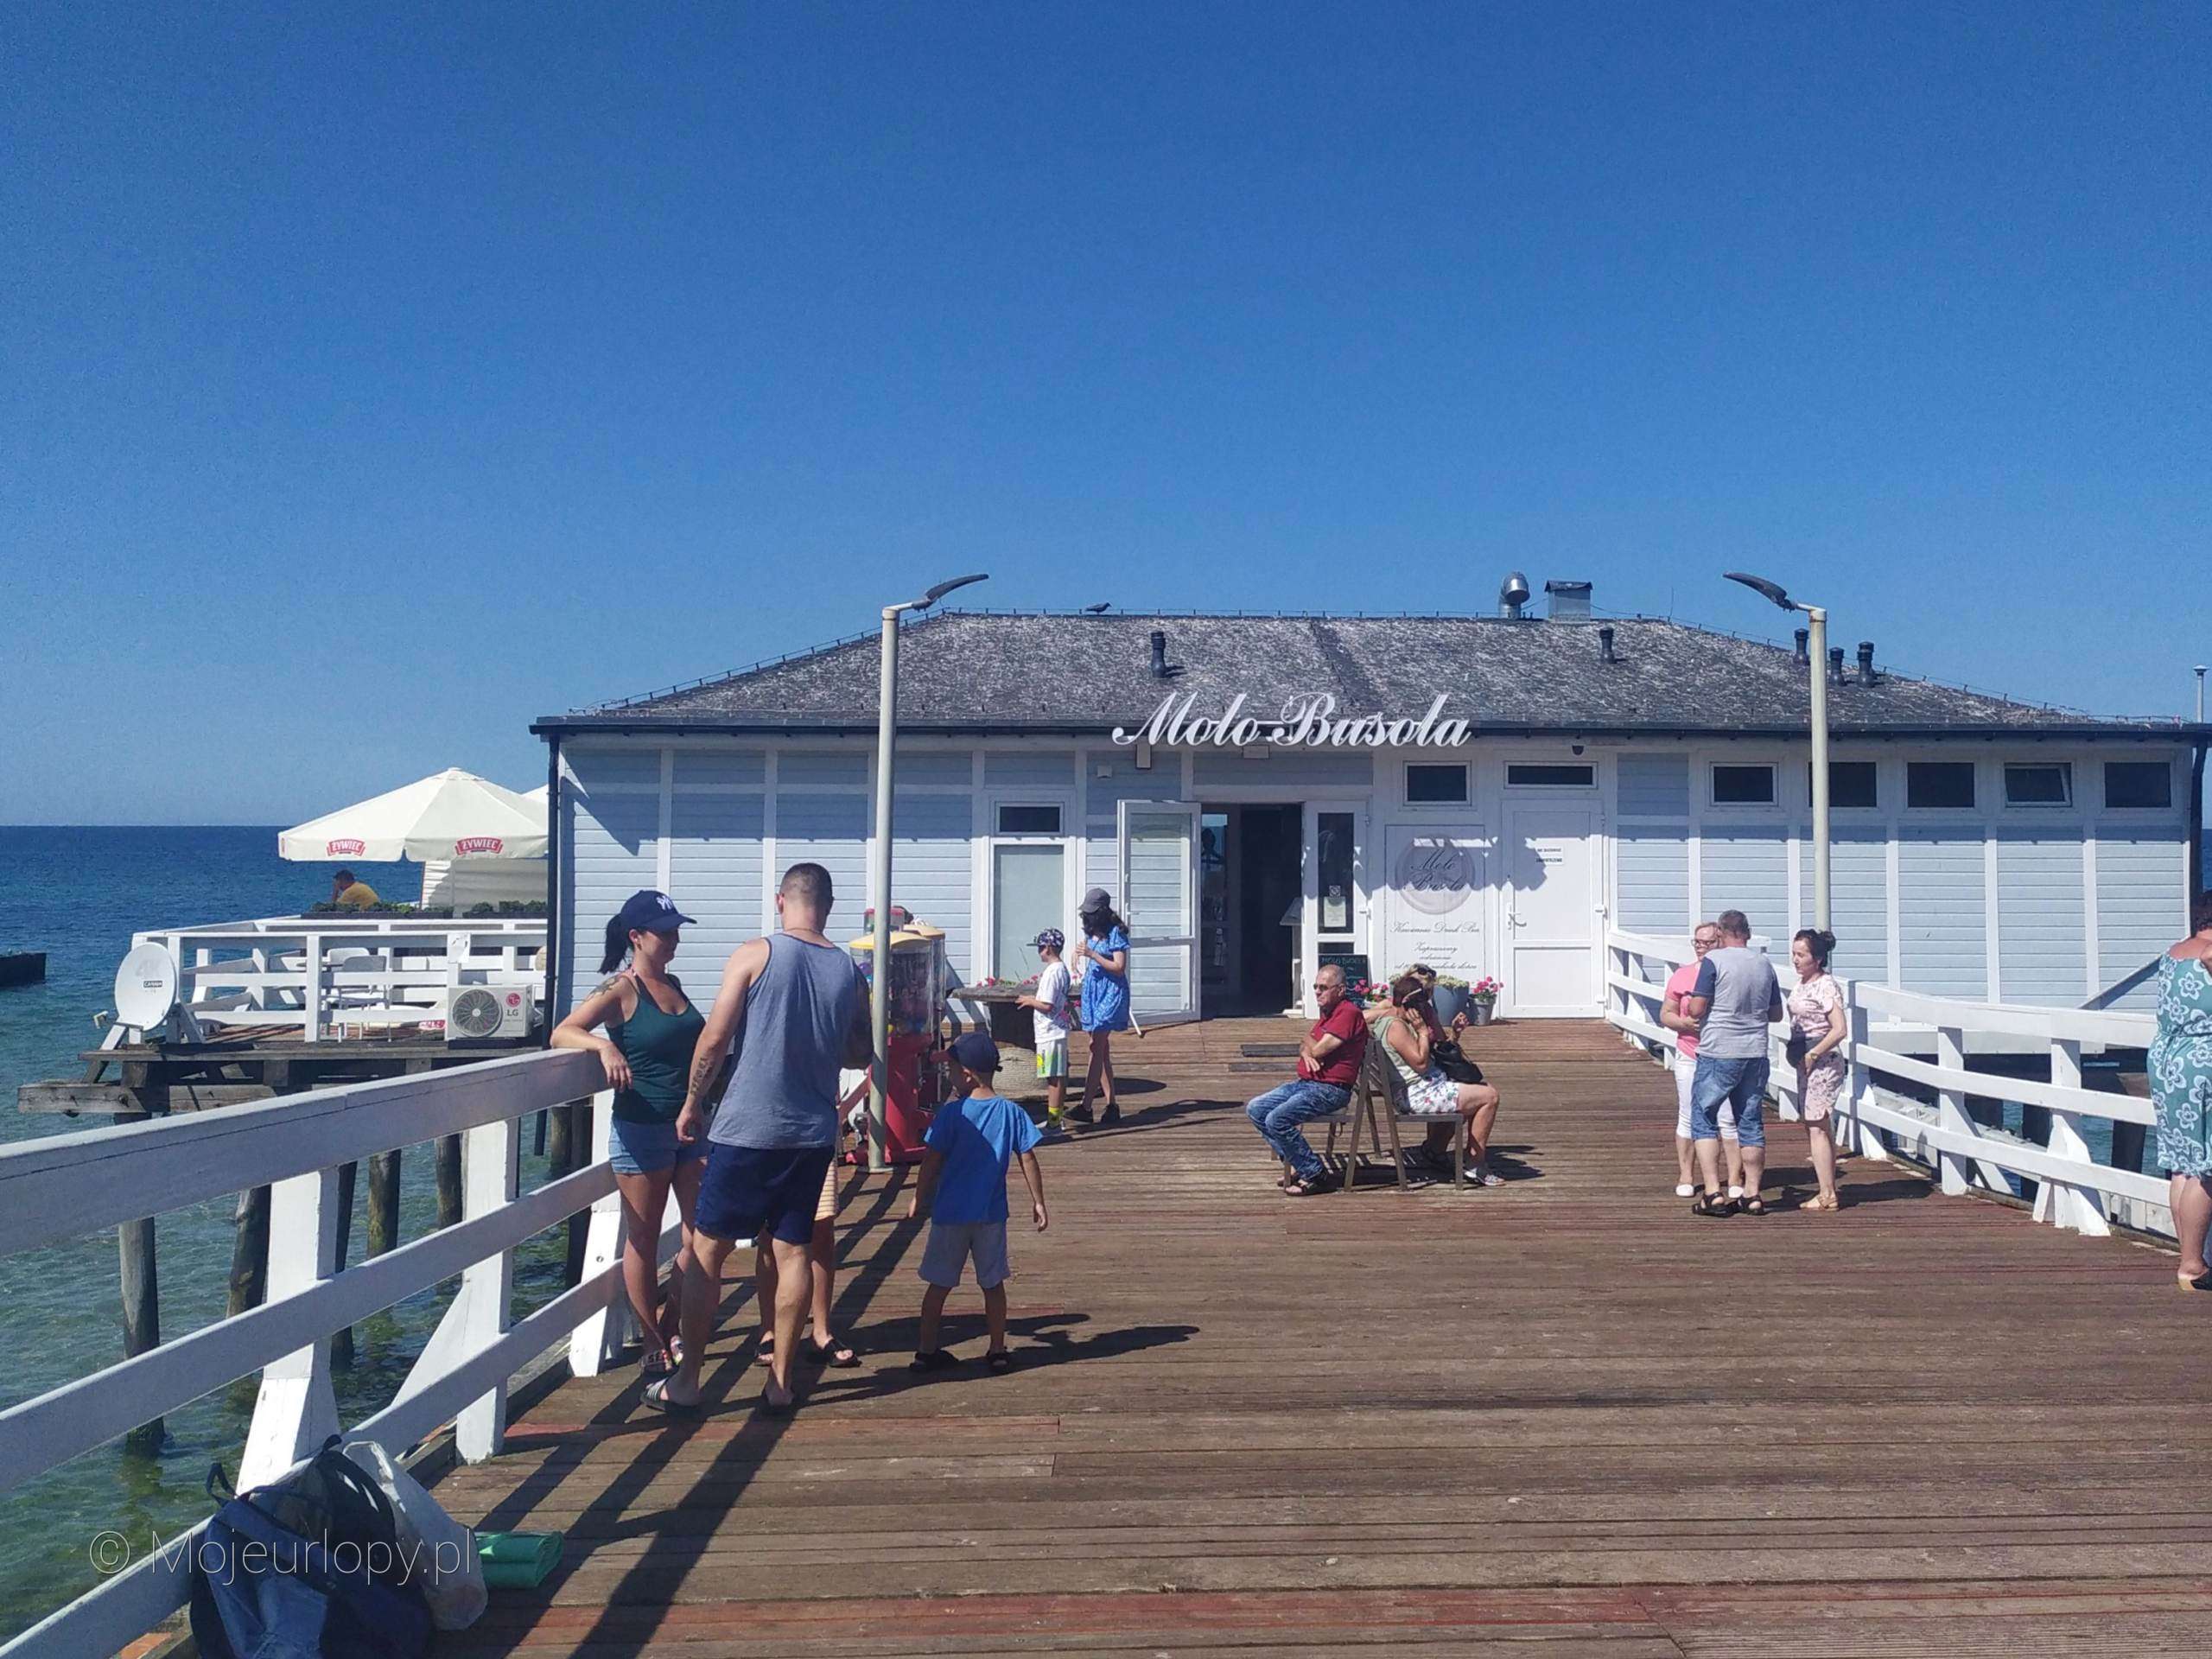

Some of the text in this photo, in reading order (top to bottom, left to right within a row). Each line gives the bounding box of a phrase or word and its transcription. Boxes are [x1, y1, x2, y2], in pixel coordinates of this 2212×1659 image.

[1112, 691, 1471, 747] Molo Busola
[507, 1008, 519, 1017] LG
